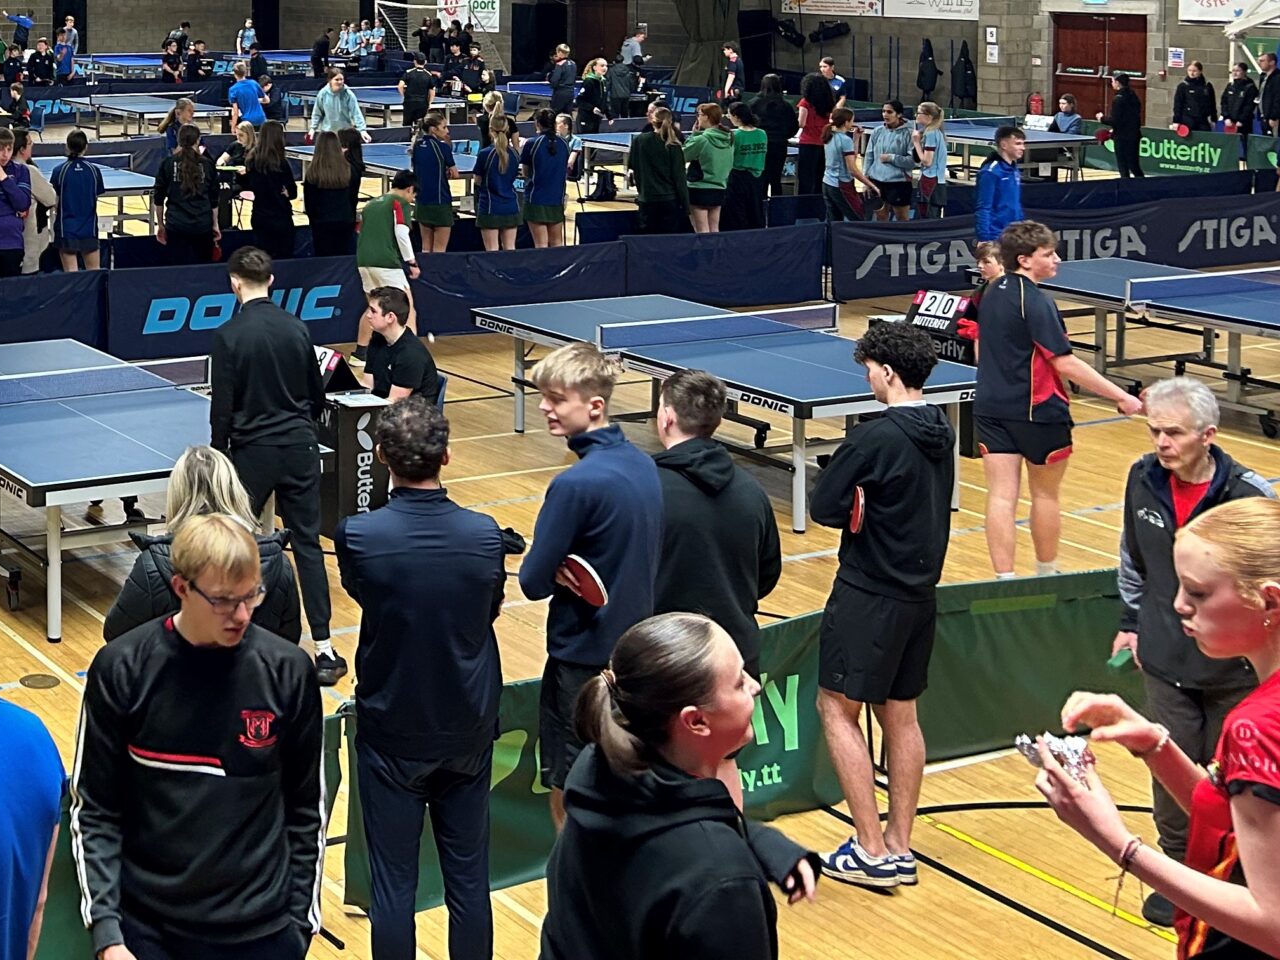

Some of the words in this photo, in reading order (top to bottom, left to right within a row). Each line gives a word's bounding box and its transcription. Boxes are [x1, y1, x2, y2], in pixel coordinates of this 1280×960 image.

[1139, 137, 1222, 167] Butterfly
[1054, 226, 1147, 261] TIGA
[1178, 216, 1277, 253] STIGA
[856, 240, 977, 280] STIGA
[142, 285, 342, 335] DOIC
[924, 295, 938, 312] 2
[942, 298, 955, 315] 0
[479, 318, 514, 335] DONIC
[934, 339, 966, 360] erfly
[740, 393, 790, 414] DONIC
[357, 451, 374, 513] Butter
